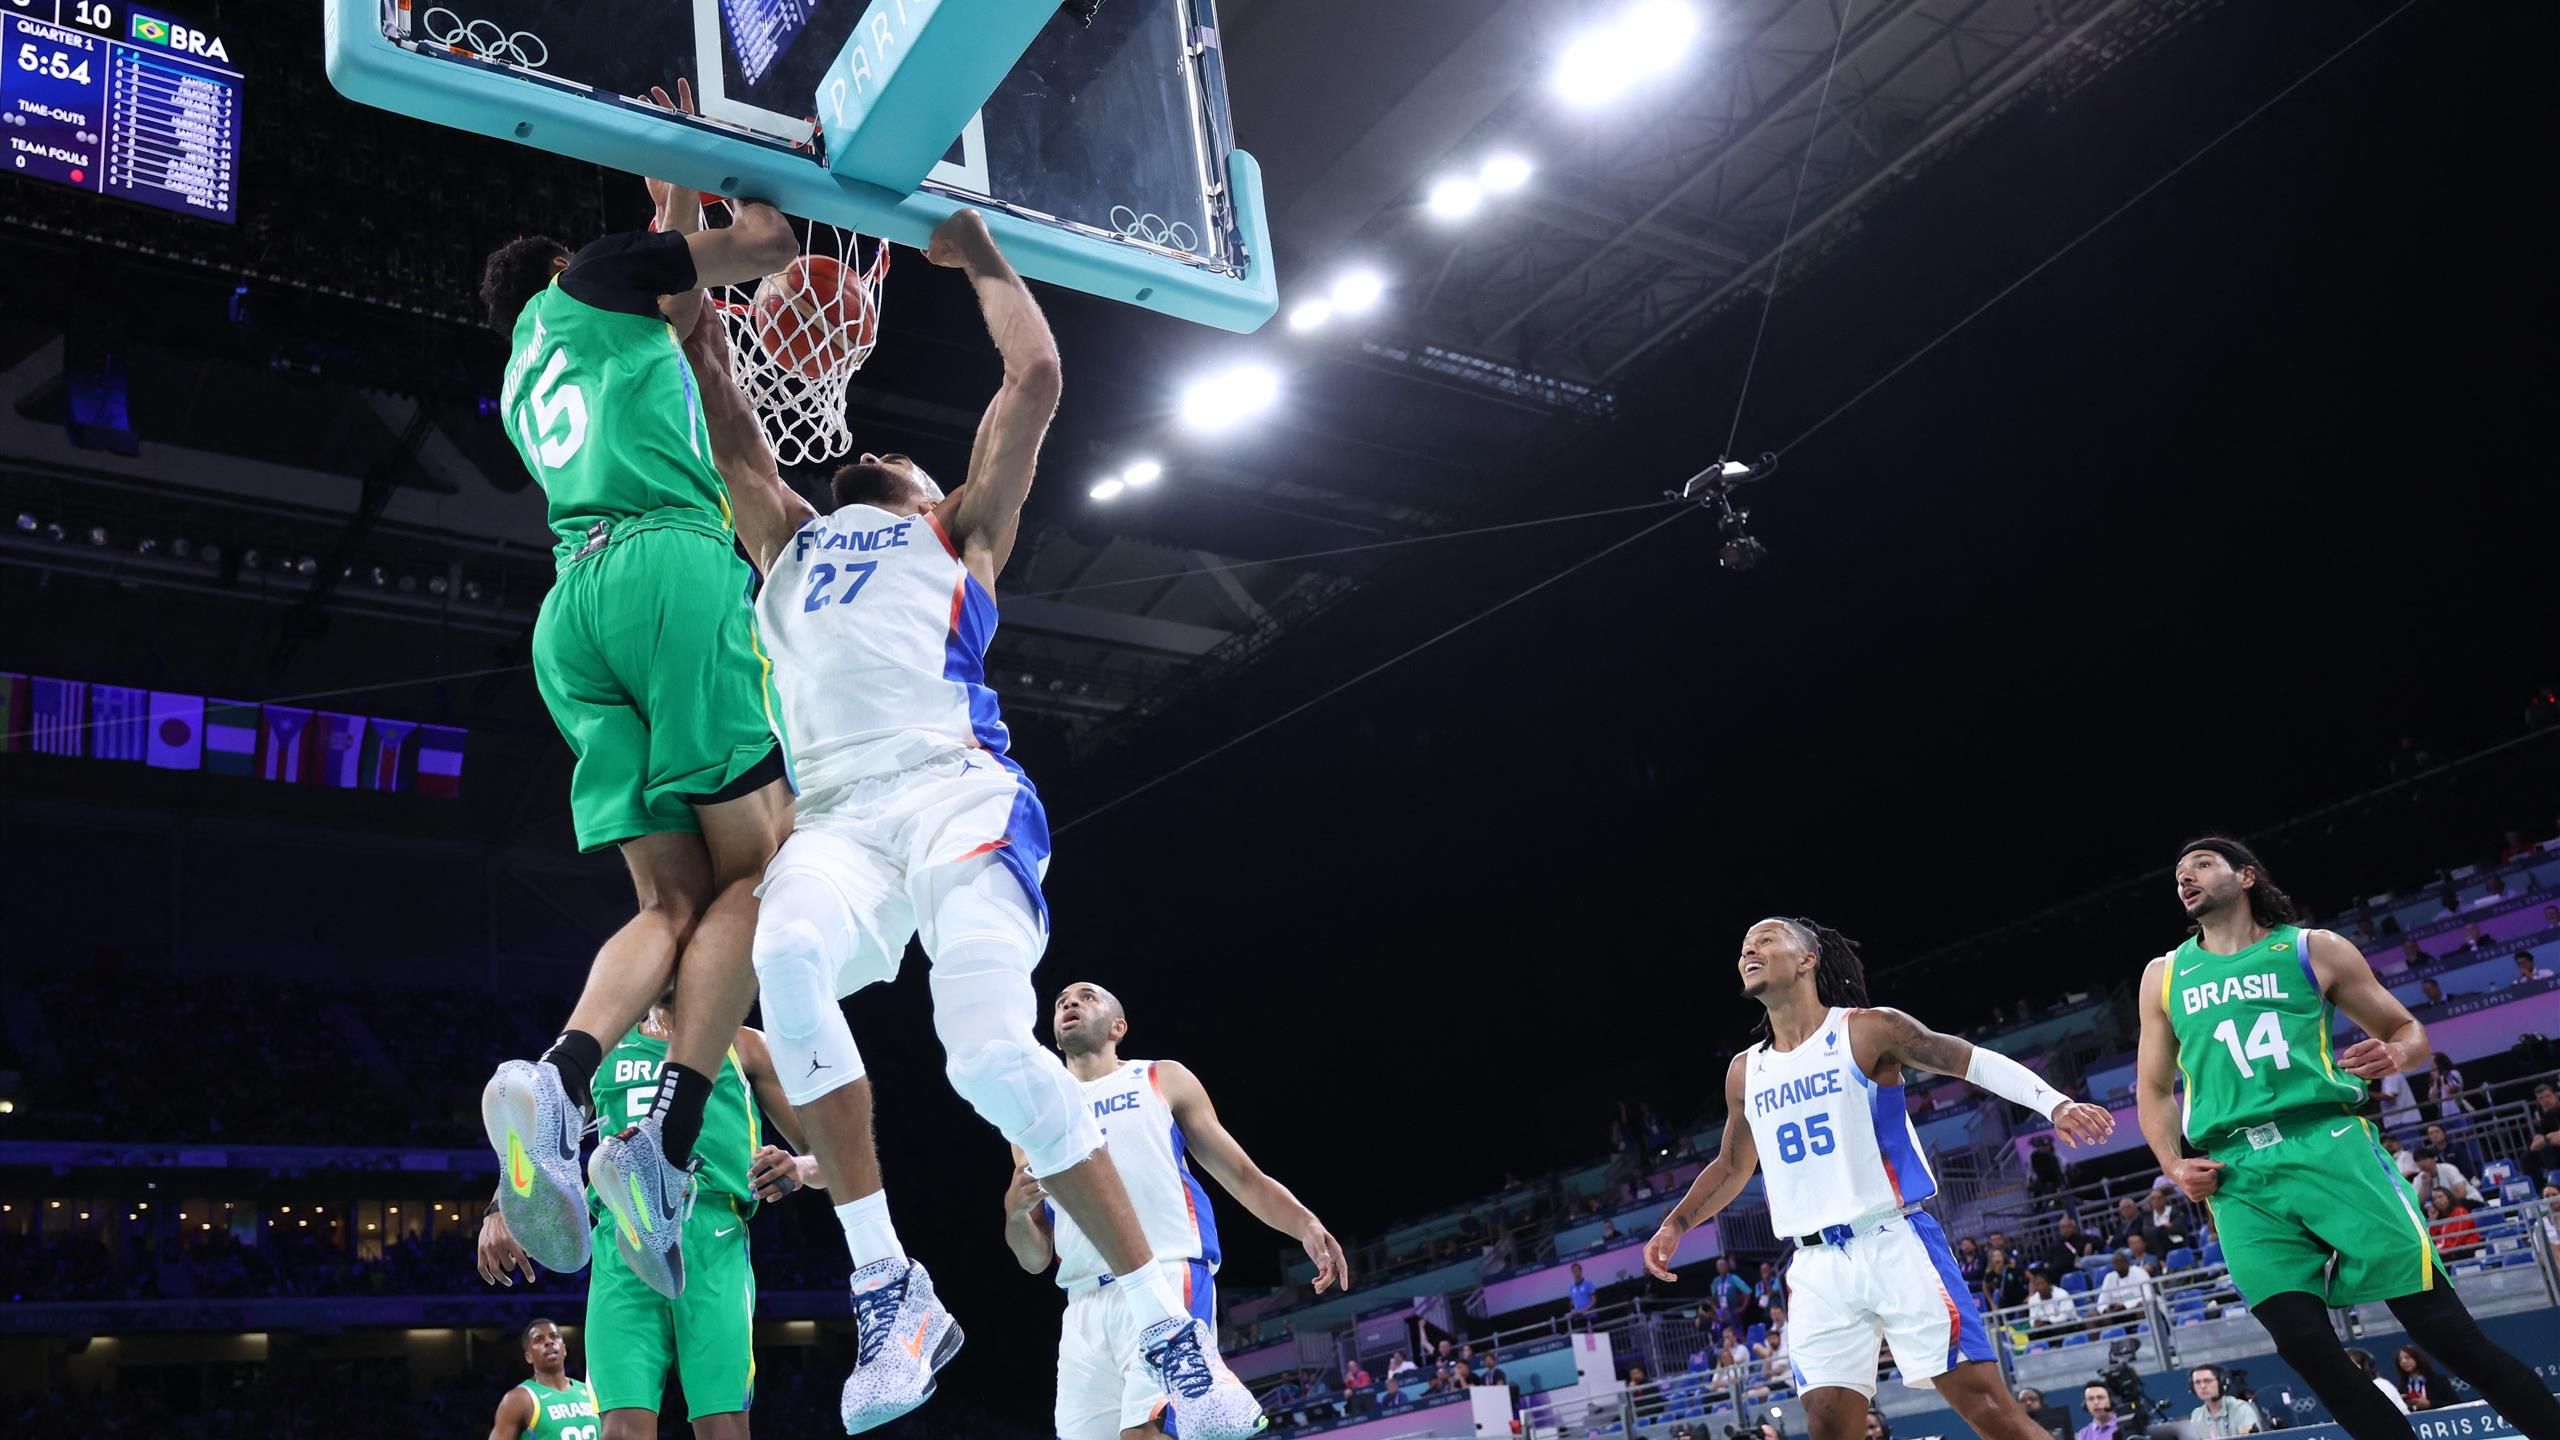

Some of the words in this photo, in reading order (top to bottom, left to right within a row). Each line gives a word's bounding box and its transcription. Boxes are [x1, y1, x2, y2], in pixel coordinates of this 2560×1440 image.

[75, 0, 112, 29] 10
[17, 19, 82, 48] QUARTER
[84, 38, 94, 51] 1
[170, 24, 230, 63] BRA
[17, 42, 91, 86] 5:54
[831, 0, 919, 127] PARI
[17, 98, 86, 127] TIME-OUTS
[10, 137, 47, 156] TEAM
[48, 147, 89, 167] FOULS
[15, 154, 26, 168] 0
[797, 523, 911, 562] FRANCE
[804, 560, 878, 613] 27
[2182, 973, 2289, 1015] BRASIL
[2213, 1011, 2290, 1078] 14
[1094, 1090, 1139, 1118] NCE
[1755, 1068, 1842, 1118] FRANCE
[1776, 1112, 1835, 1164] 85
[547, 1401, 593, 1420] BRAS
[2412, 1418, 2473, 1440] ARIS
